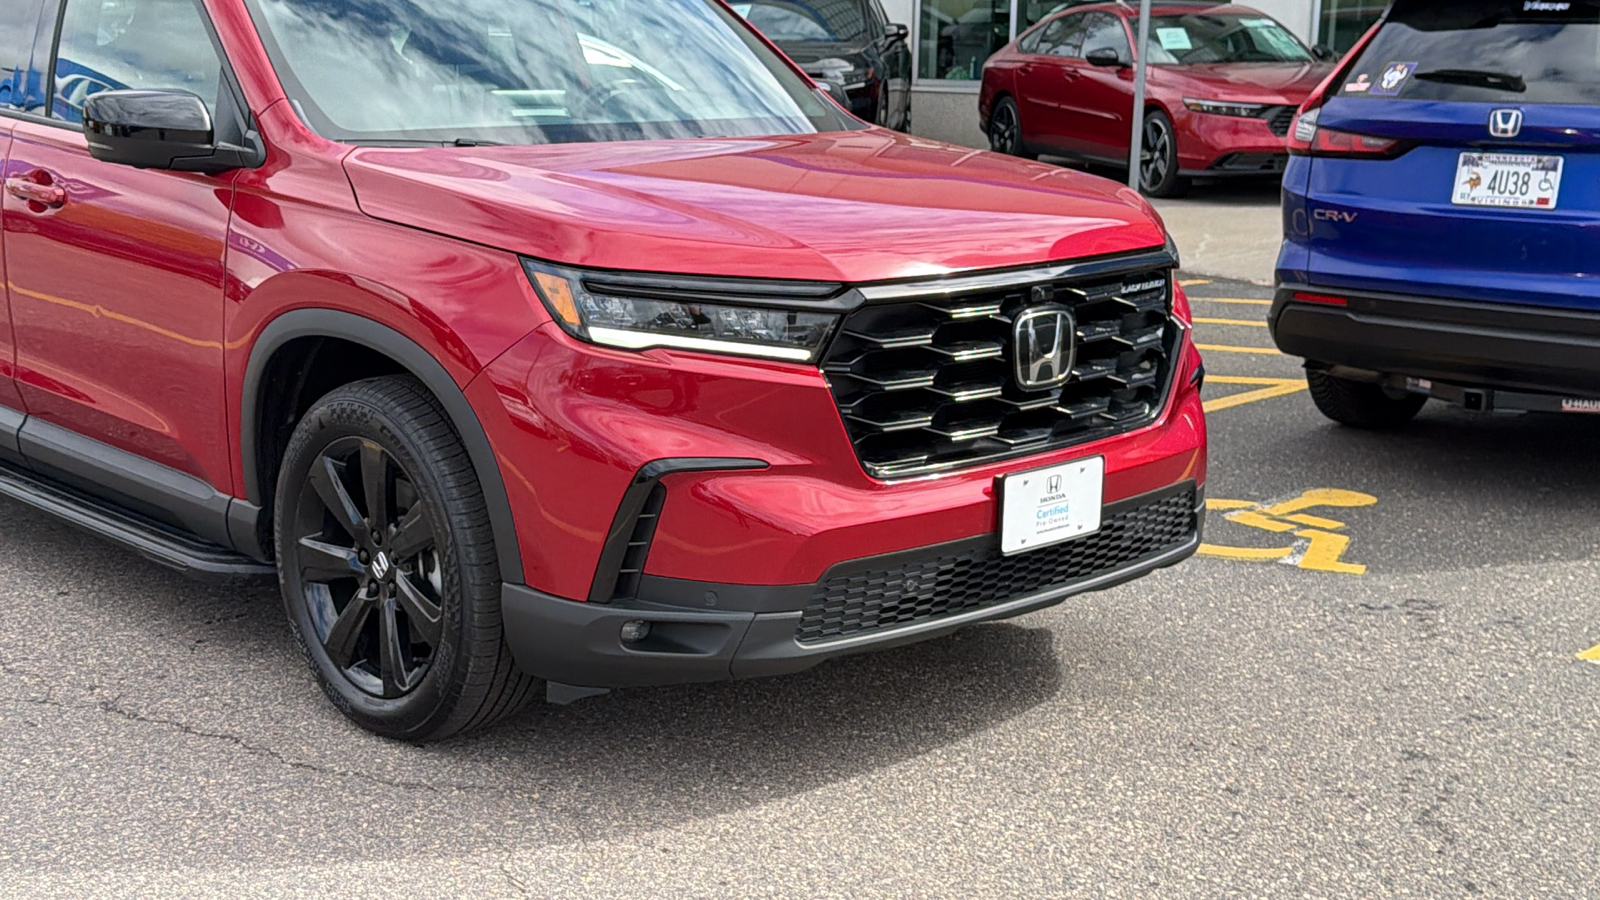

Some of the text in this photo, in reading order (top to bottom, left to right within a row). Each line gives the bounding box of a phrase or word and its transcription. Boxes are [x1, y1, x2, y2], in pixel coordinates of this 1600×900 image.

[1487, 169, 1532, 196] 4U38
[1313, 208, 1358, 223] CR-V
[1040, 493, 1066, 503] HONDA
[1037, 503, 1069, 519] Certified
